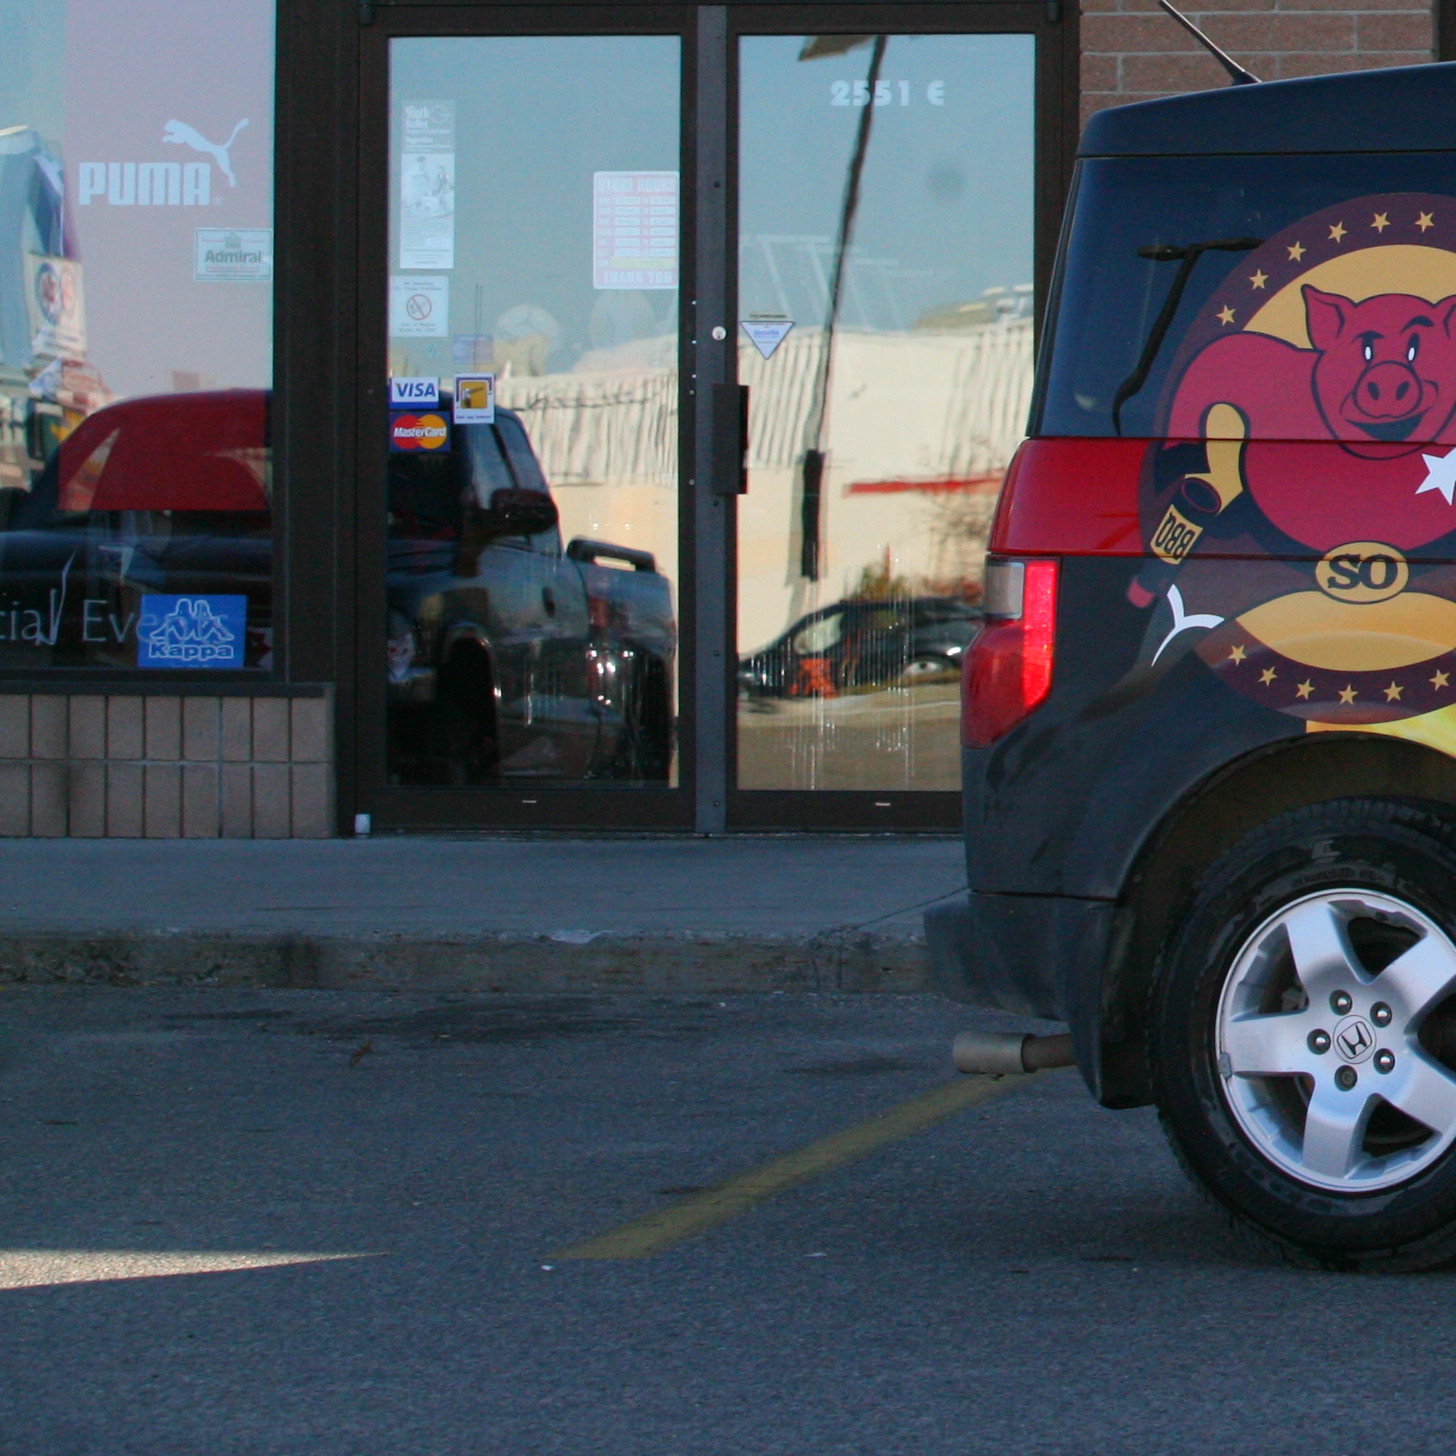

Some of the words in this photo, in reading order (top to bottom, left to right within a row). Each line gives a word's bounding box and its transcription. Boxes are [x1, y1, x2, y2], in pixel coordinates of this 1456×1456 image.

[830, 80, 910, 106] 2551
[78, 162, 211, 206] PUMA
[205, 250, 262, 263] Admiral
[395, 382, 436, 397] VISA
[393, 426, 447, 438] MasterCard
[1327, 555, 1399, 590] SO
[149, 644, 234, 661] Kappa
